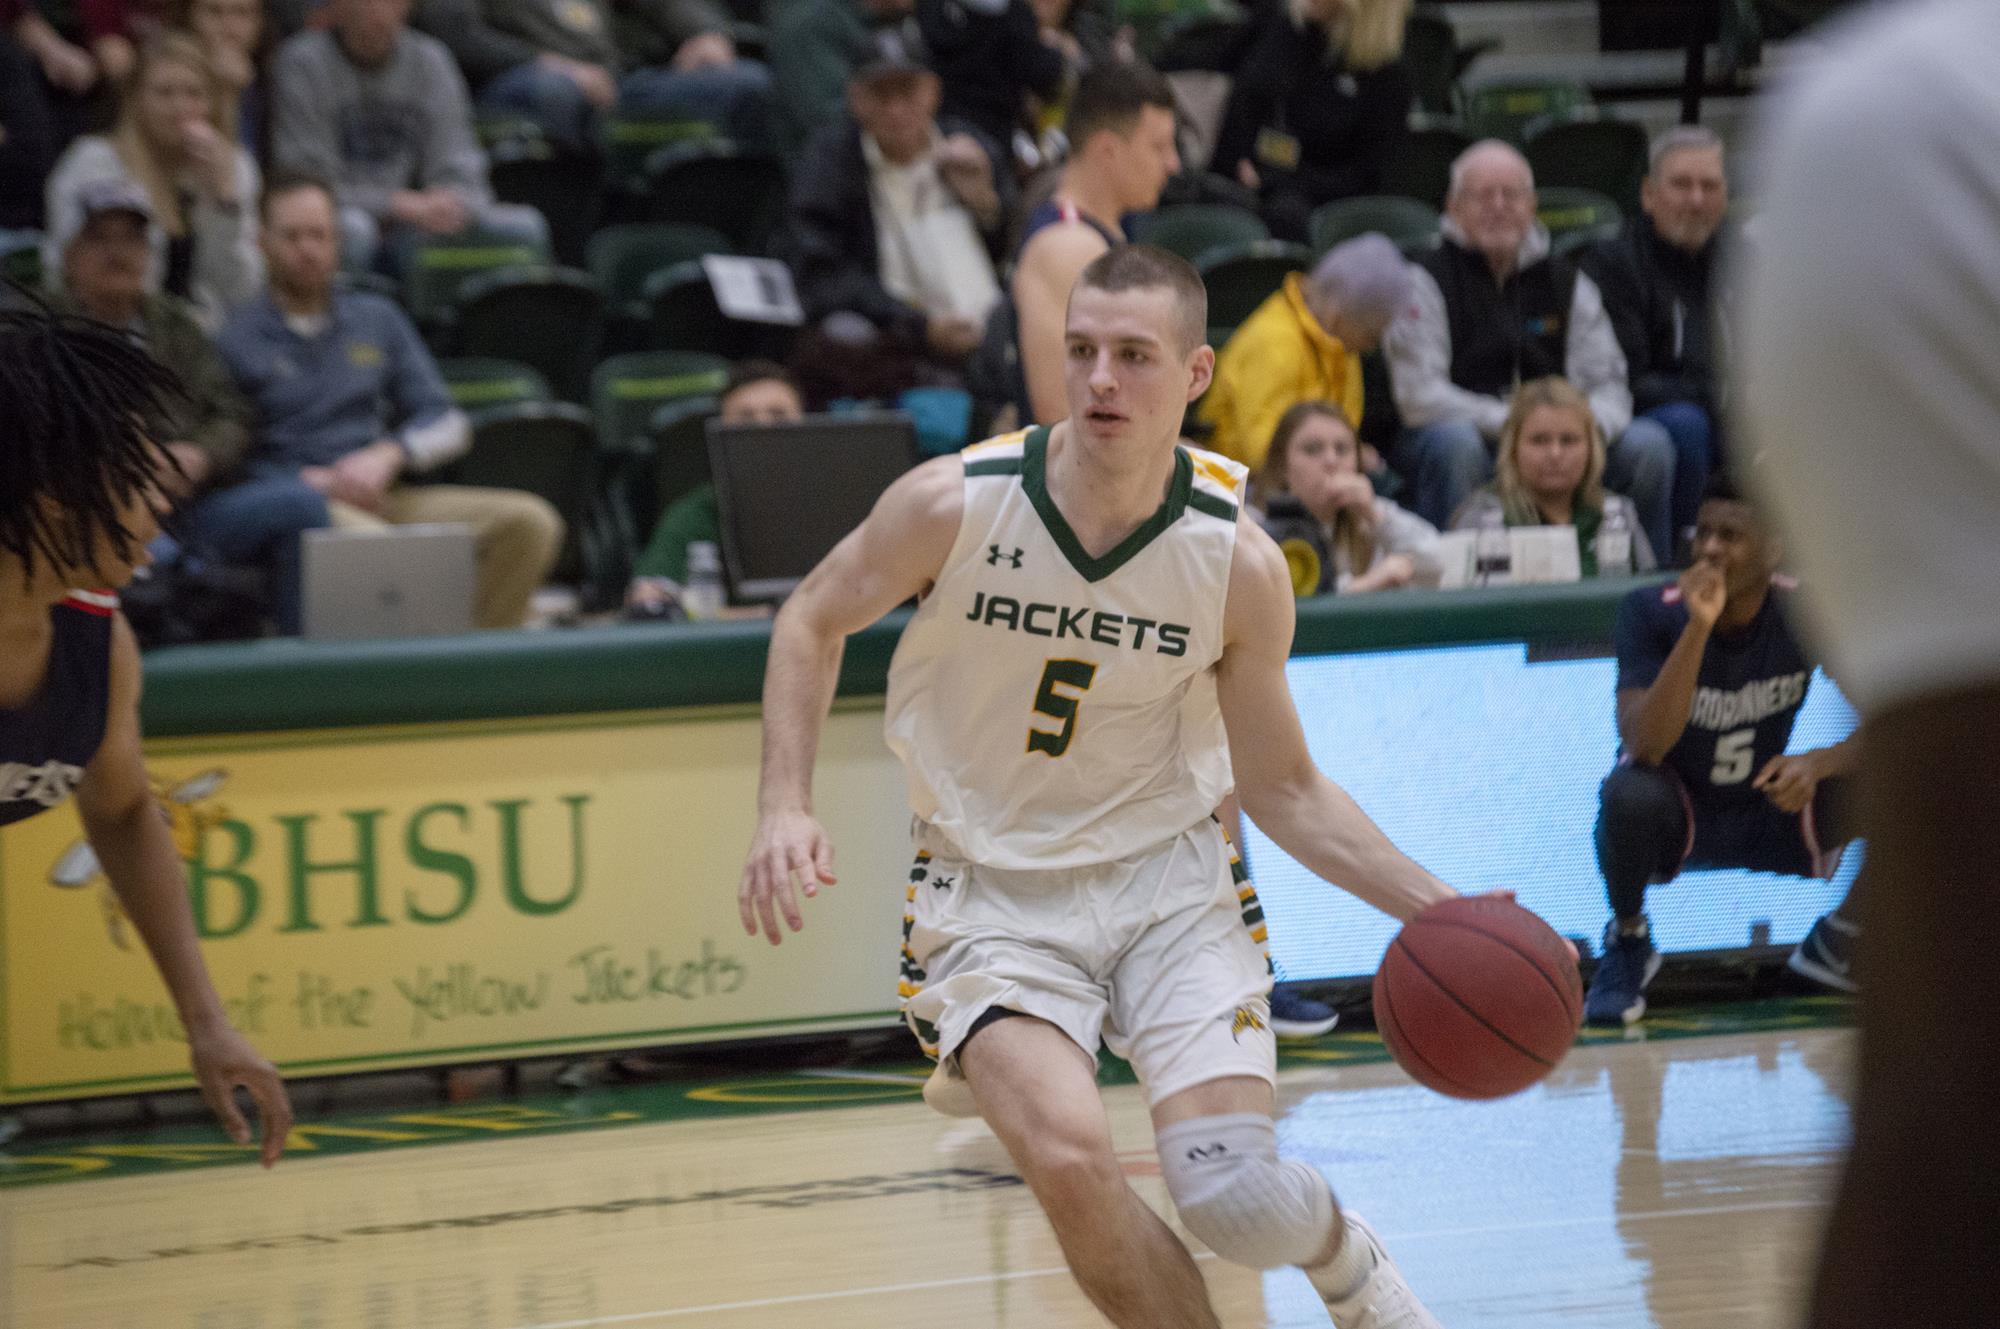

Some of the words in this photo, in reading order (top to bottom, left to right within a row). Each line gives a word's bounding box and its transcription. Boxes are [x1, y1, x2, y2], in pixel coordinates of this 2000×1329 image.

[966, 592, 1191, 657] JACKETS
[1025, 657, 1098, 757] 5
[1710, 728, 1756, 784] 5
[189, 794, 592, 940] BHSU
[392, 961, 548, 1040] Yellow
[567, 939, 746, 1005] Jackets
